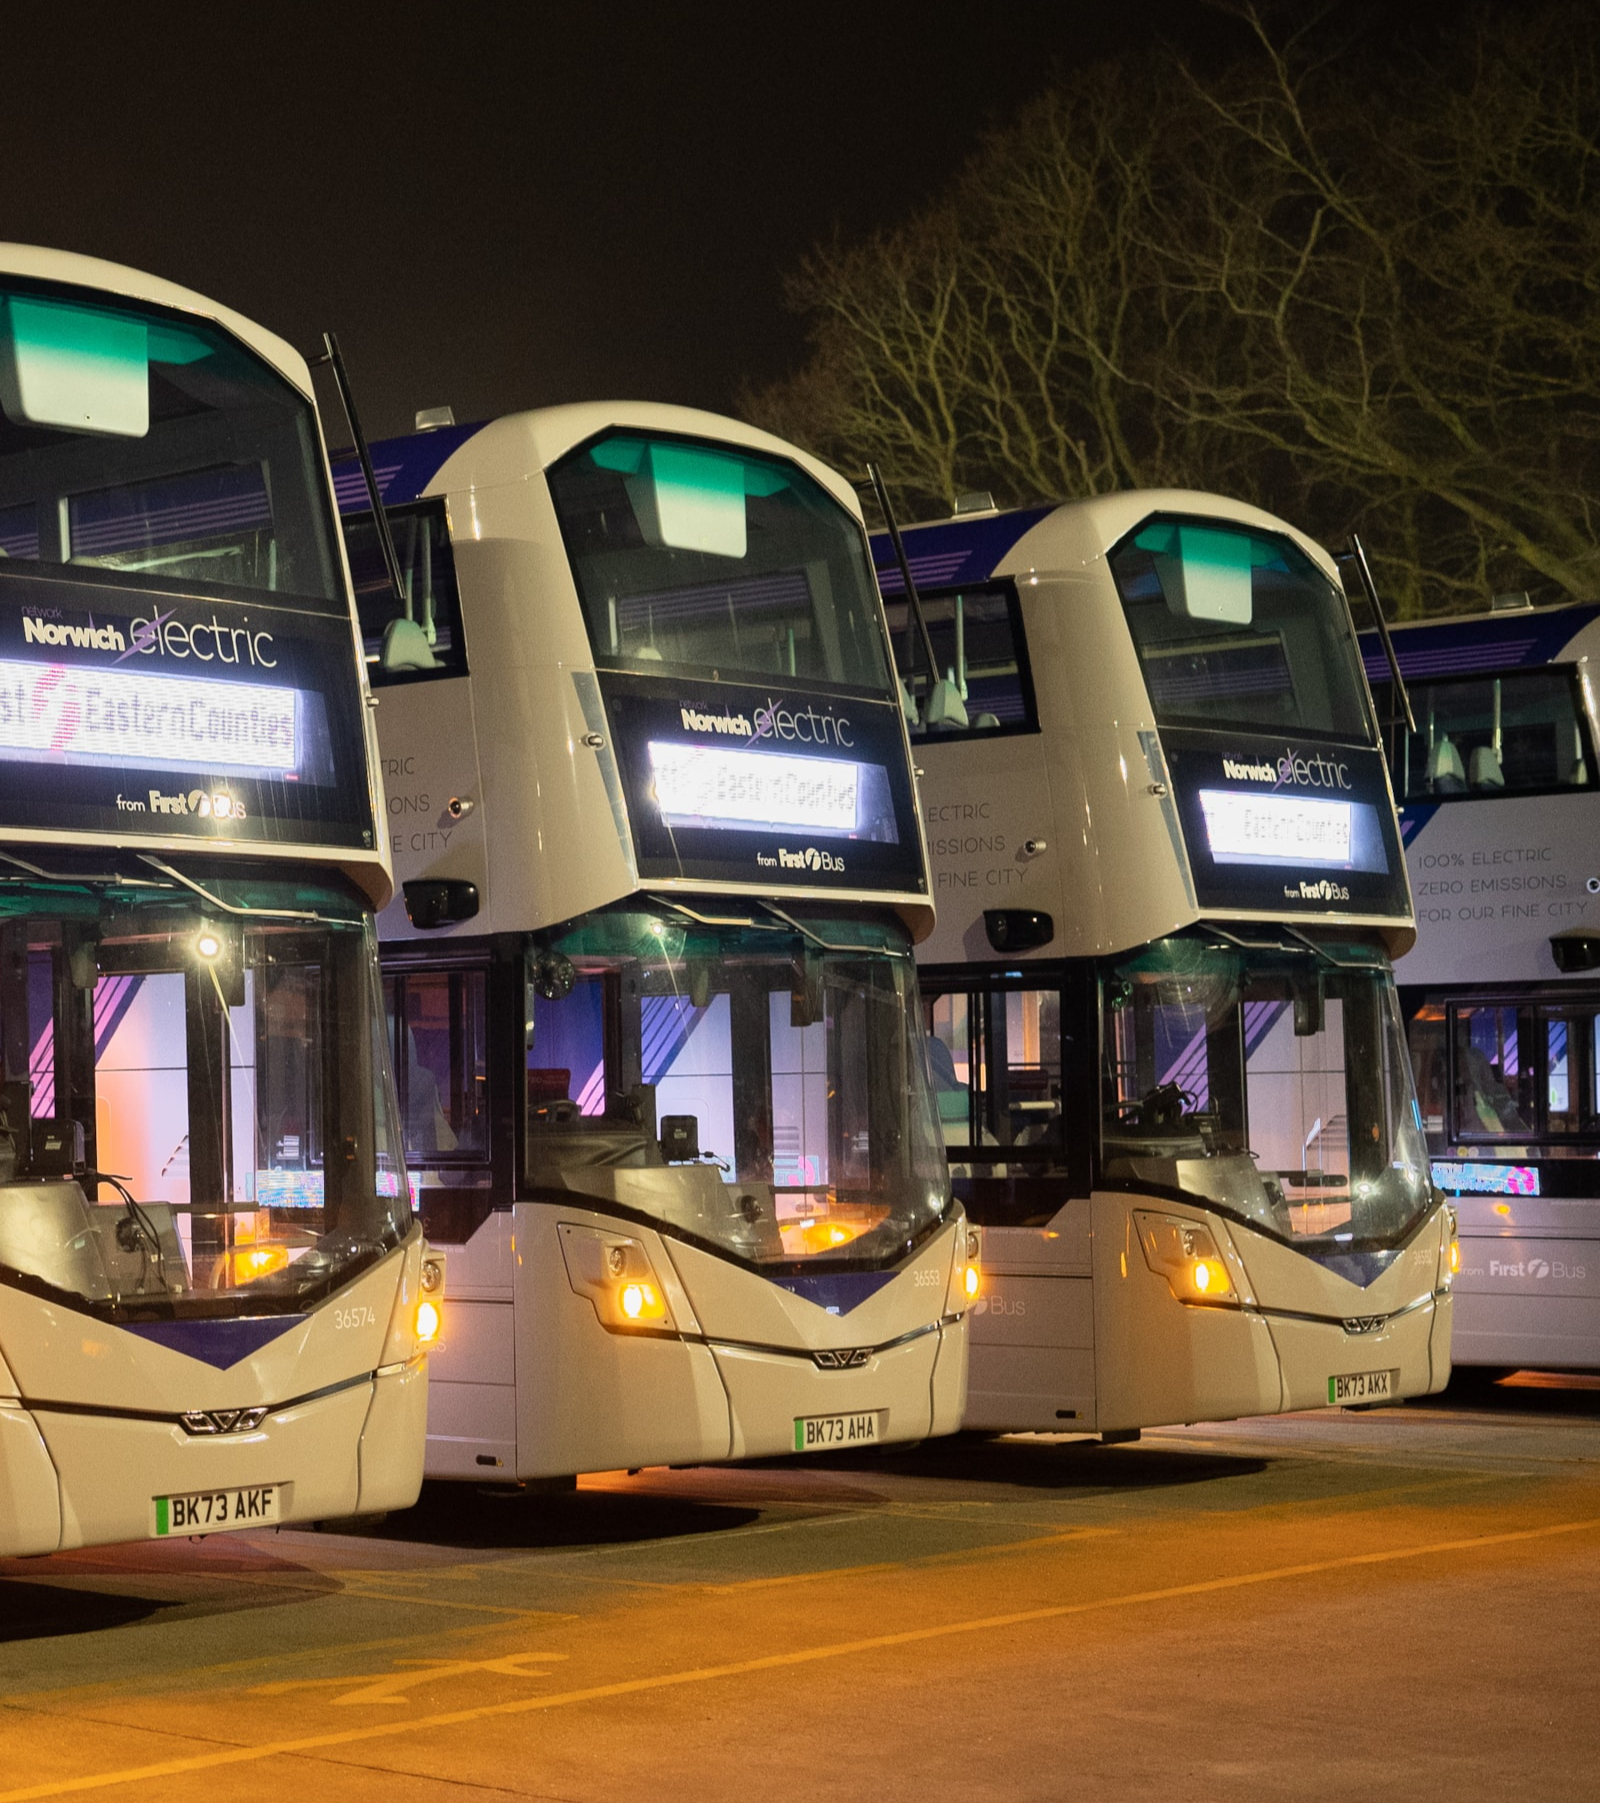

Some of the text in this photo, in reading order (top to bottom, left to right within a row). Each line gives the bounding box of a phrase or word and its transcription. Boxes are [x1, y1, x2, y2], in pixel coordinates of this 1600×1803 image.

[21, 605, 63, 620] network
[23, 605, 277, 668] Norwich electric
[86, 687, 293, 747] EasternCounties
[680, 697, 854, 748] Norwich electric
[1223, 747, 1352, 790] Norwich electric
[116, 790, 246, 819] from First Bus
[924, 802, 990, 823] ECTRIC
[411, 830, 452, 851] CITY
[927, 835, 1005, 856] ISSIONS
[757, 848, 845, 872] from First Bus
[1419, 848, 1552, 869] 100% ELECTRIC
[938, 868, 1028, 888] FINE CITY
[1418, 874, 1567, 896] ZERO EMISSIONS
[1284, 881, 1350, 900] from First Bus
[1419, 901, 1588, 923] FOR OUR FINE CITY
[913, 1270, 940, 1287] 36553
[1460, 1260, 1586, 1279] from First Bus
[991, 1295, 1025, 1316] Bus
[334, 1306, 376, 1329] 36574
[1337, 1374, 1388, 1398] BK73 AKX
[806, 1416, 874, 1444] BK73 AHA
[173, 1489, 273, 1527] BK73 AKF
